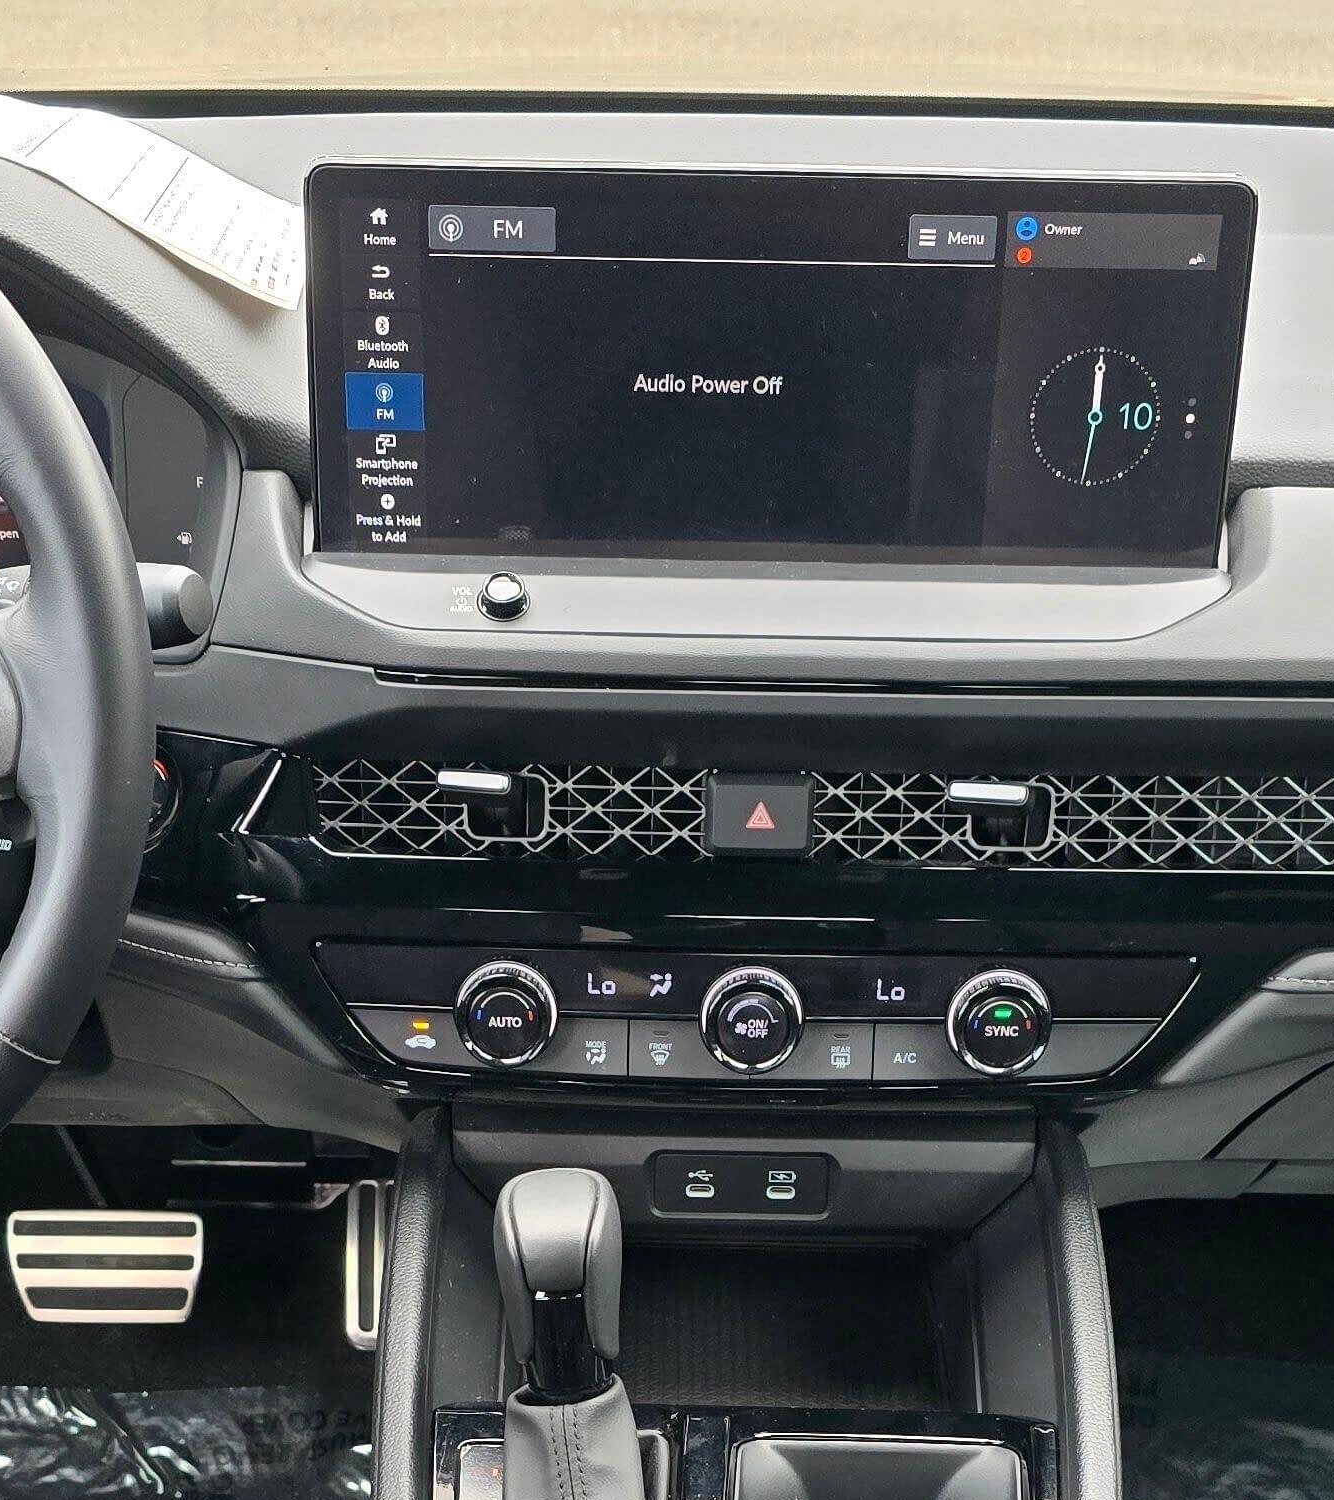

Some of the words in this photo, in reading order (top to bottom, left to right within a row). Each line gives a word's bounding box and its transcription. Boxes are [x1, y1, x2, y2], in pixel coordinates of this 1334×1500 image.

[492, 219, 523, 239] FM
[1044, 223, 1083, 236] Owner
[363, 234, 397, 246] Home
[947, 231, 985, 246] Menu
[368, 288, 395, 300] Back
[357, 339, 409, 352] Bluetooth
[367, 357, 400, 370] Audio
[633, 373, 686, 393] Audio
[691, 374, 749, 394] Power
[752, 375, 784, 395] Off
[376, 408, 395, 420] FM
[1119, 402, 1153, 431] 10
[355, 458, 418, 471] Smartphone
[196, 476, 204, 488] F
[361, 474, 414, 488] Projection
[356, 514, 383, 527] Press
[384, 515, 394, 526] &
[396, 515, 421, 527] Hold
[371, 531, 383, 542] to
[385, 530, 407, 543] Add
[451, 586, 473, 595] VOL
[587, 972, 617, 996] Lo
[876, 977, 906, 1001] Lo
[487, 1016, 523, 1028] AUTO
[747, 1019, 769, 1029] ON/
[747, 1028, 768, 1039] OFF
[984, 1025, 1020, 1038] SYNC
[585, 1040, 607, 1049] MODE
[648, 1042, 673, 1050] FRONT
[830, 1046, 851, 1054] REAR
[893, 1052, 917, 1064] A/C
